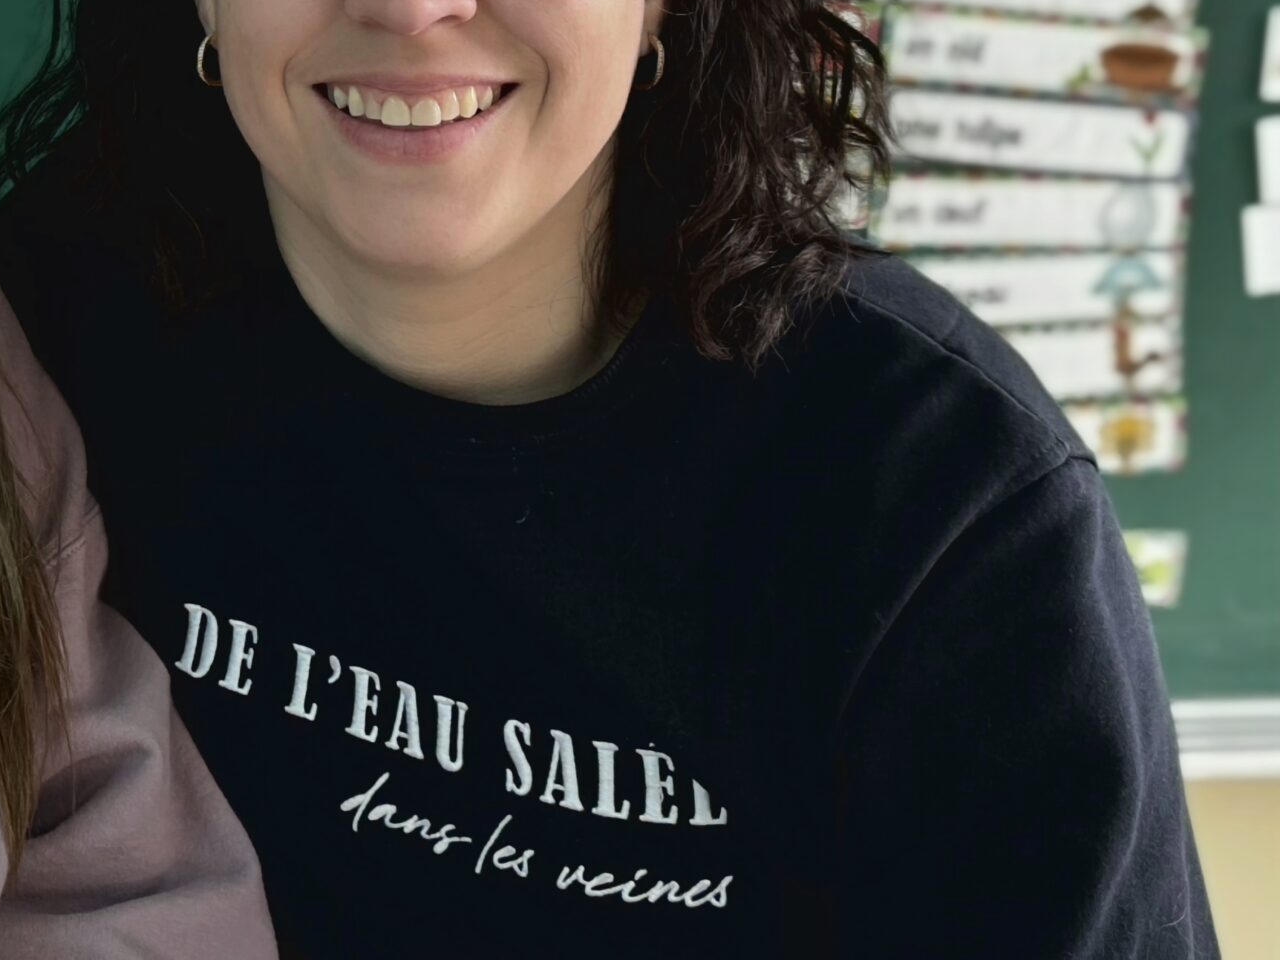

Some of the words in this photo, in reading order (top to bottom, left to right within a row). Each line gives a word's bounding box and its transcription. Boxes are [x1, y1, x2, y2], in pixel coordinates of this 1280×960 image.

[174, 603, 258, 696] DE
[340, 772, 473, 854] dans
[475, 814, 535, 876] les
[556, 863, 735, 908] veines
